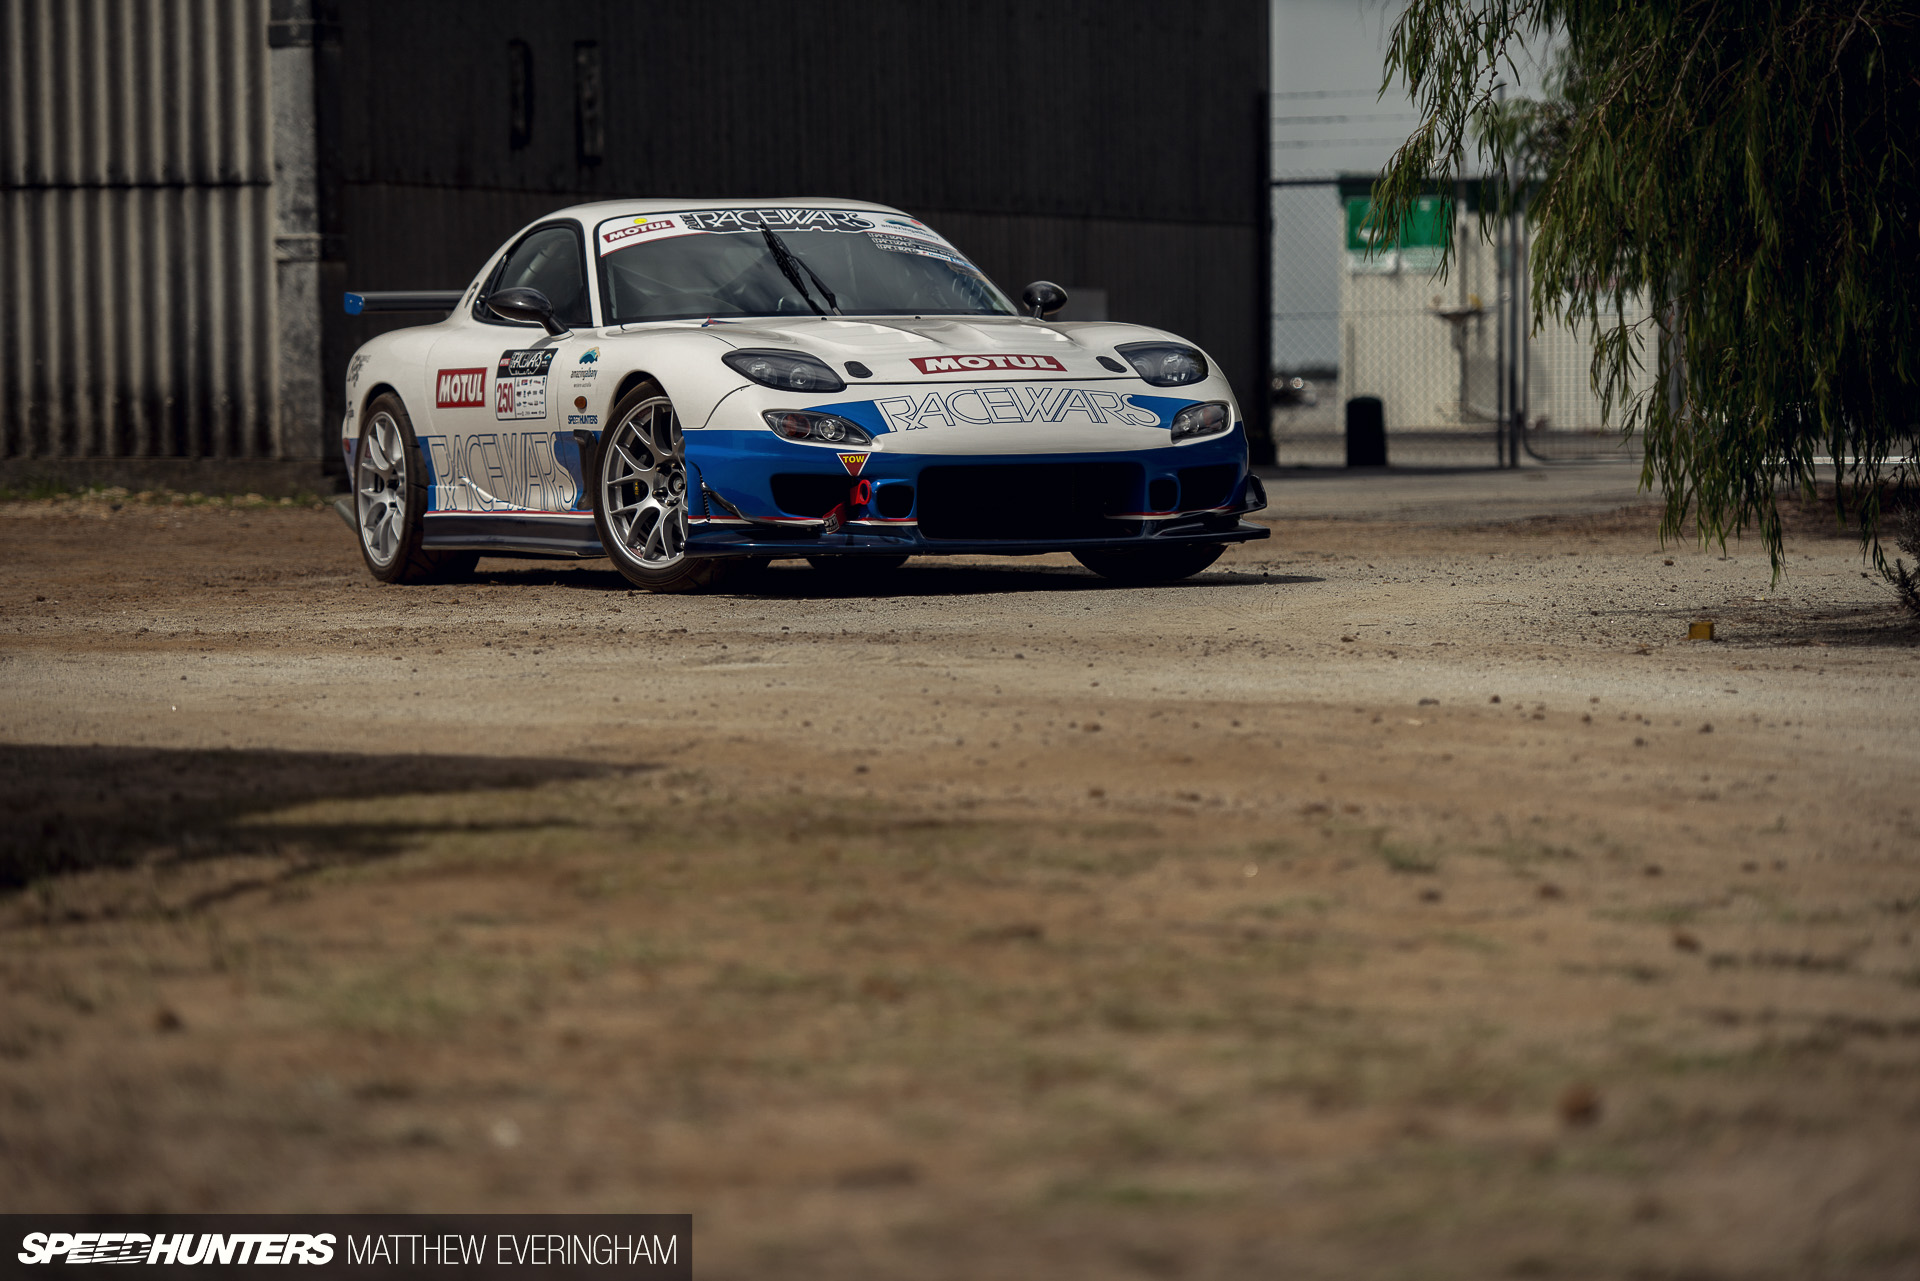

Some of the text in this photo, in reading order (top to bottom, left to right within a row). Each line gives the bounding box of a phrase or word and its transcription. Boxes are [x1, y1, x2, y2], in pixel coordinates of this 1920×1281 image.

[607, 221, 672, 241] MOTUL
[691, 209, 876, 231] RACEWARS
[926, 355, 1058, 372] MOTUL
[439, 372, 484, 403] MOTUL
[497, 382, 514, 414] 250
[874, 386, 1162, 432] RACEWARS
[427, 431, 578, 513] RACEWARS
[842, 455, 865, 464] TOW
